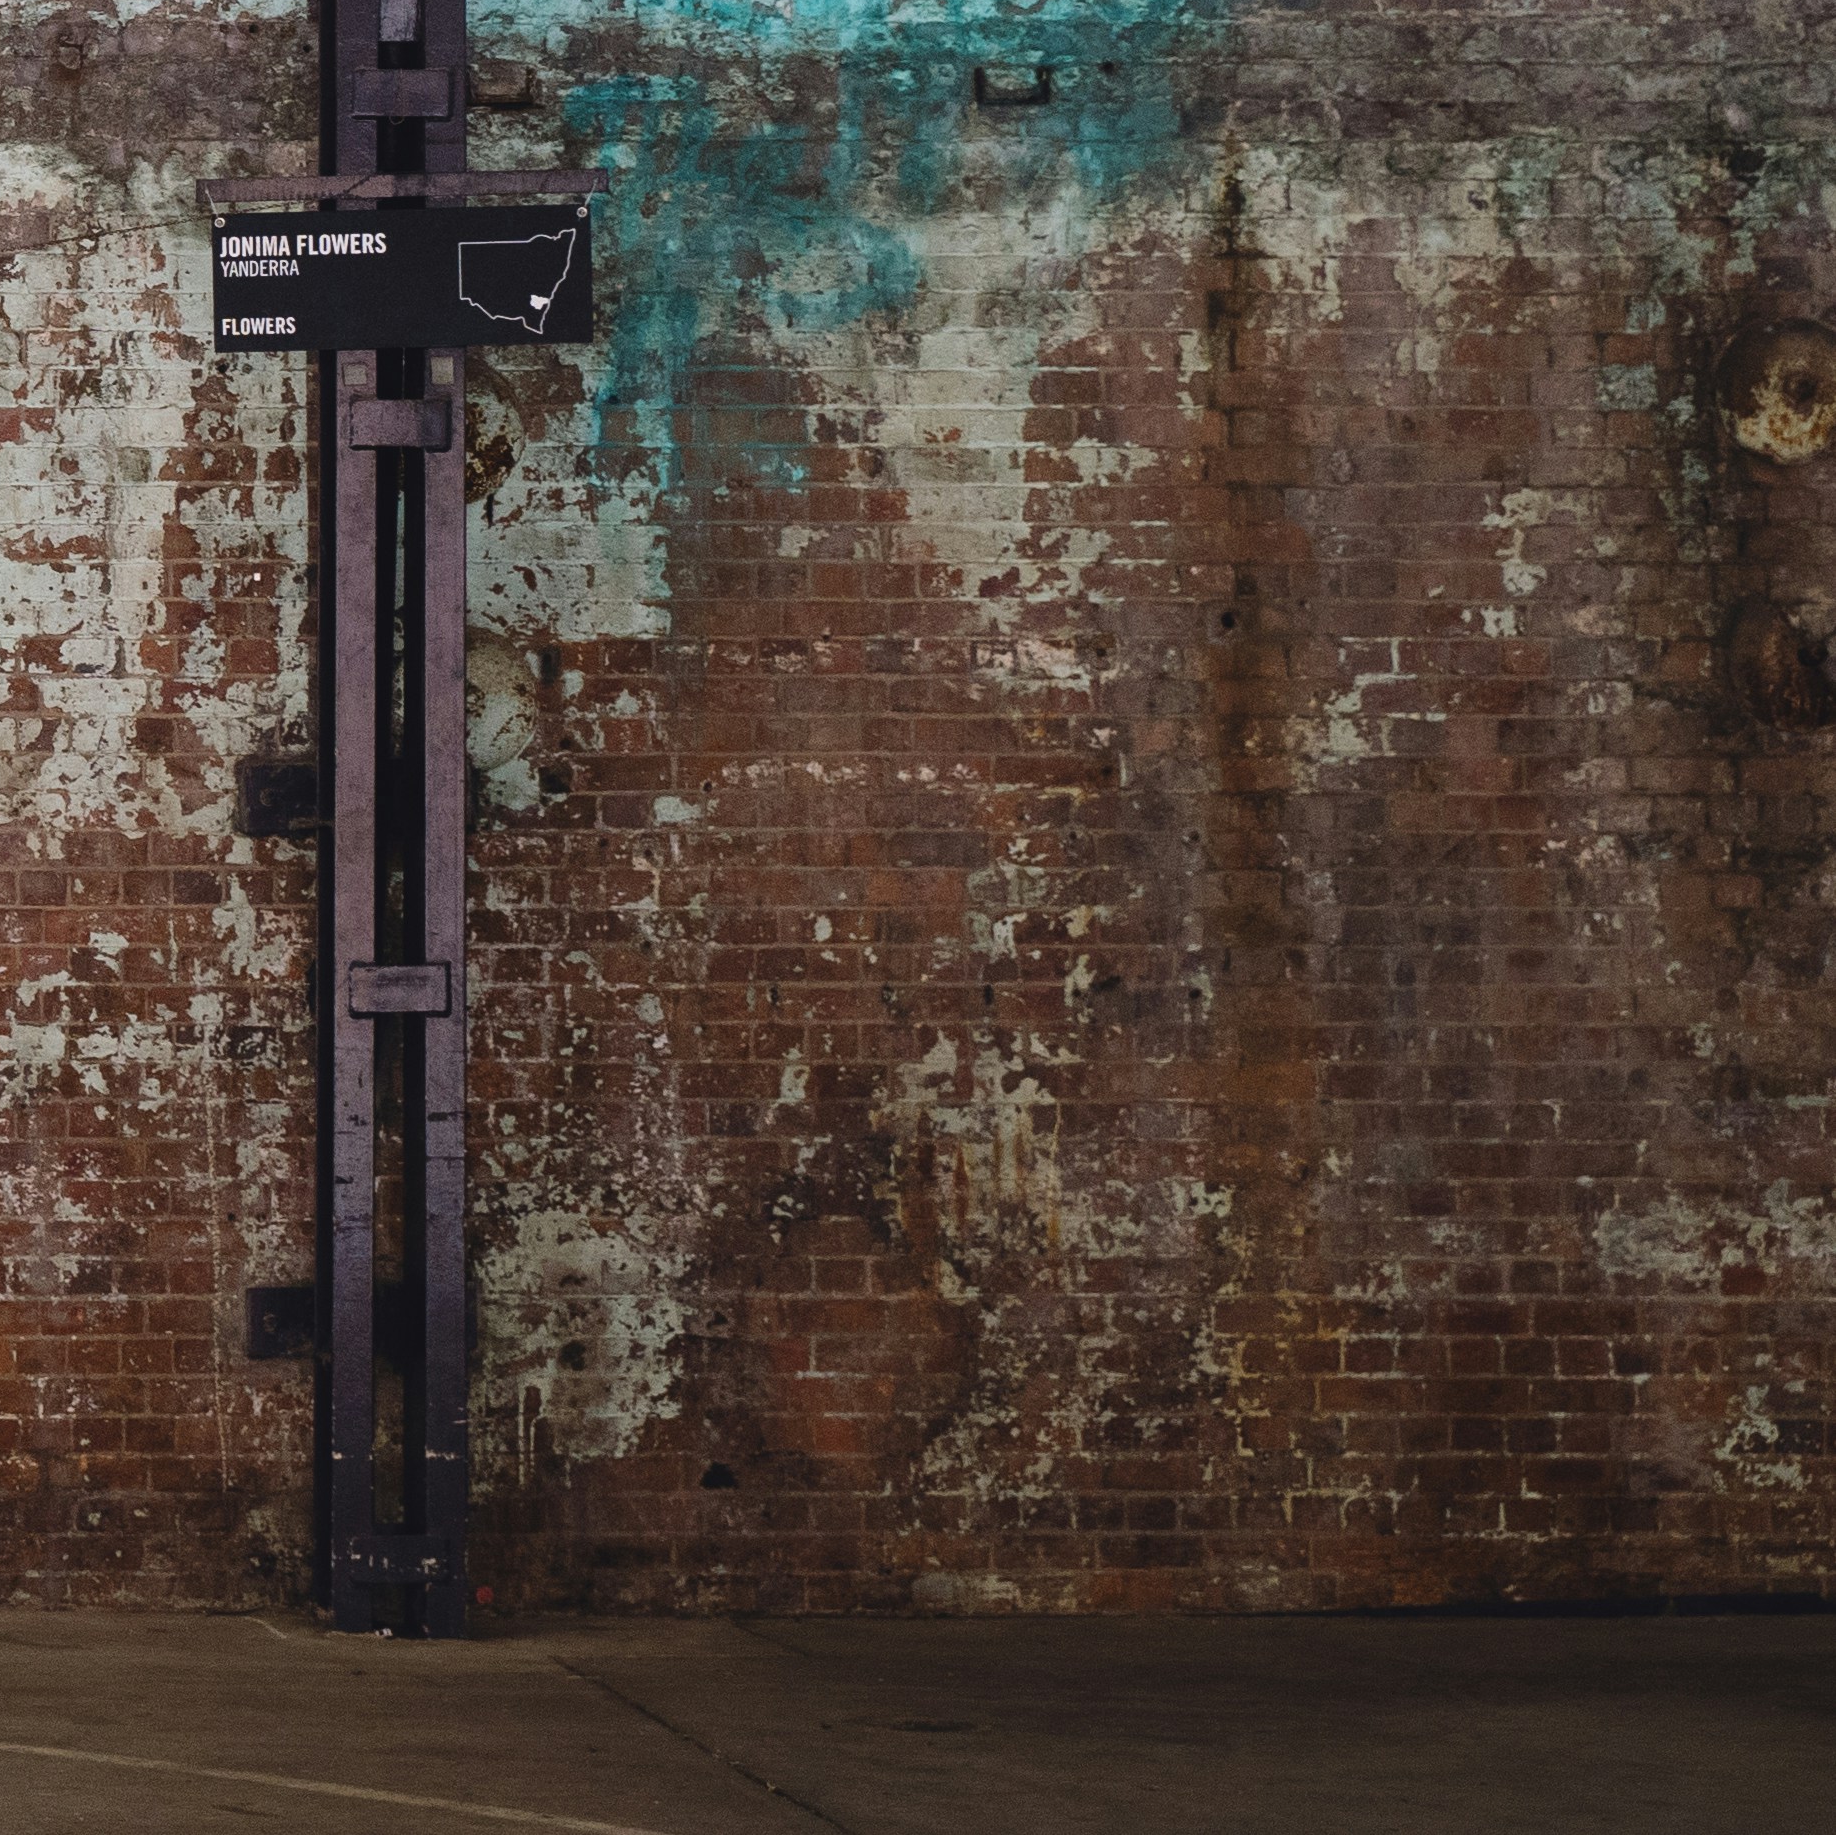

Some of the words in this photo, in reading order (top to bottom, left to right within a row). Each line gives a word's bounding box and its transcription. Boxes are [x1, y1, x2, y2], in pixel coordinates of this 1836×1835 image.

[220, 235, 291, 258] JONIMA
[296, 233, 387, 256] FLOWERS
[221, 260, 300, 278] YANDERRA
[222, 317, 296, 336] FLOWERS
